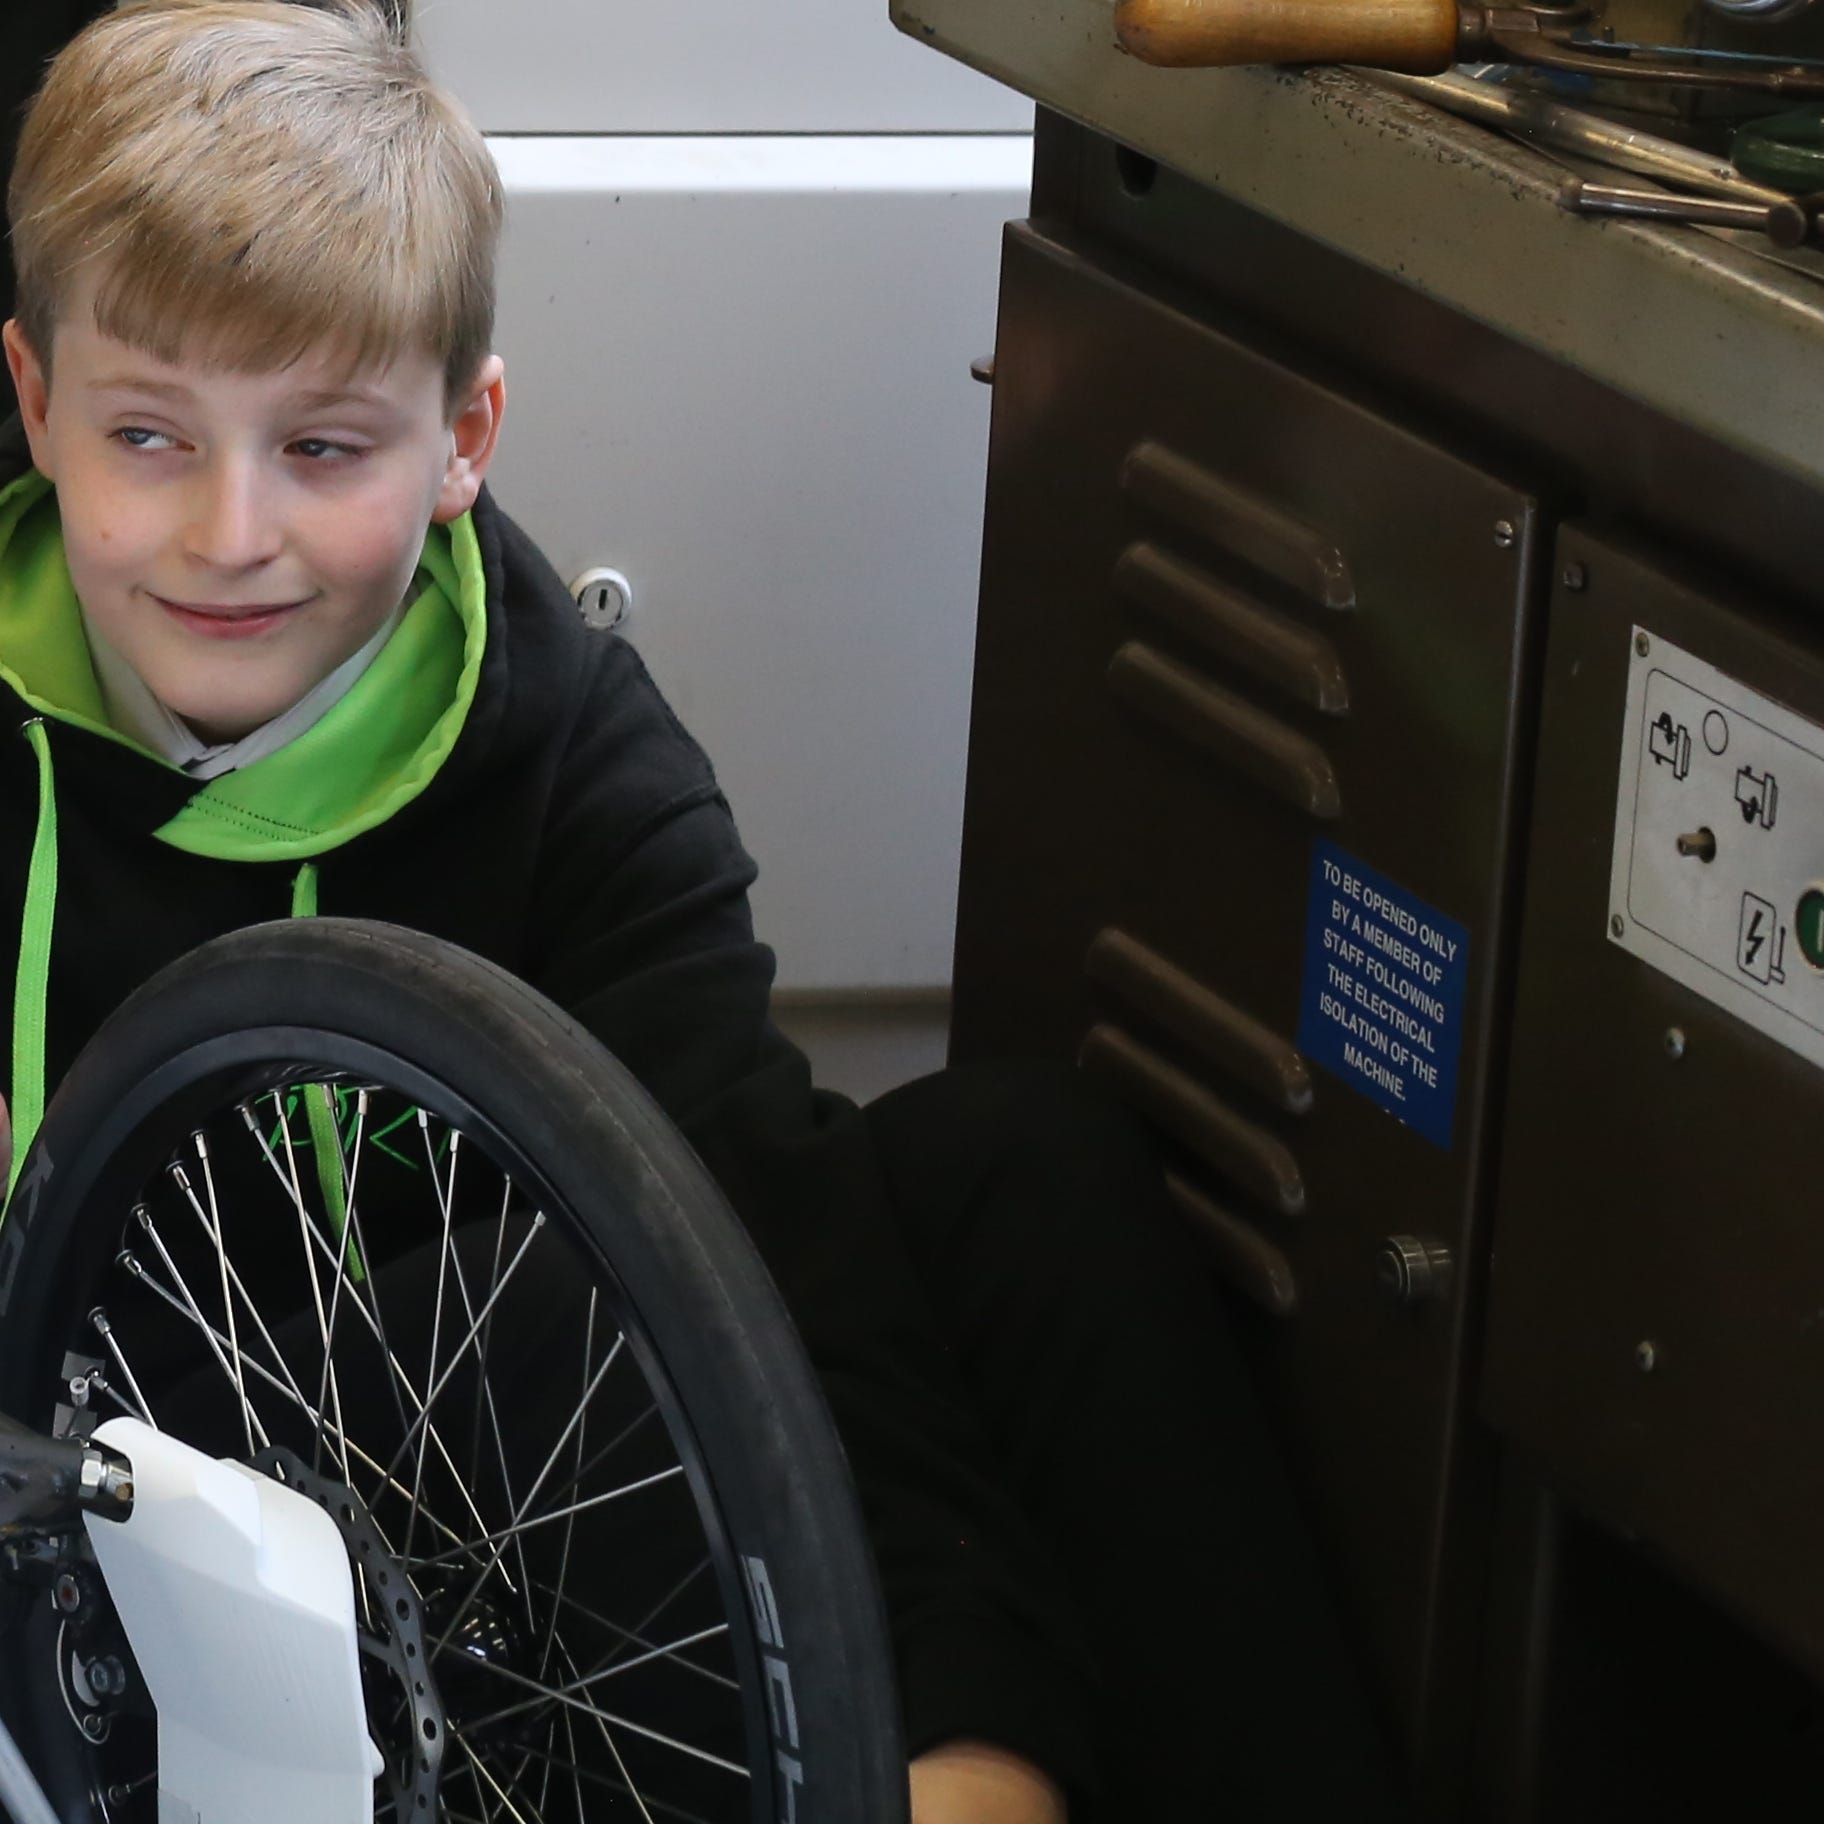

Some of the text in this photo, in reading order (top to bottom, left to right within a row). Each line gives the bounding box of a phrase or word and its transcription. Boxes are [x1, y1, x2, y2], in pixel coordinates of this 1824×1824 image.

[1323, 859, 1457, 962] TO BE OPENED ONLY
[1332, 899, 1443, 986] BY A MEMBER OF
[1323, 927, 1445, 1025] STAFF FOLLOWING
[1327, 963, 1435, 1053] THE ELECTRICAL
[1319, 991, 1438, 1089] ISOLATION OF THE
[1344, 1042, 1406, 1101] MACHINE.
